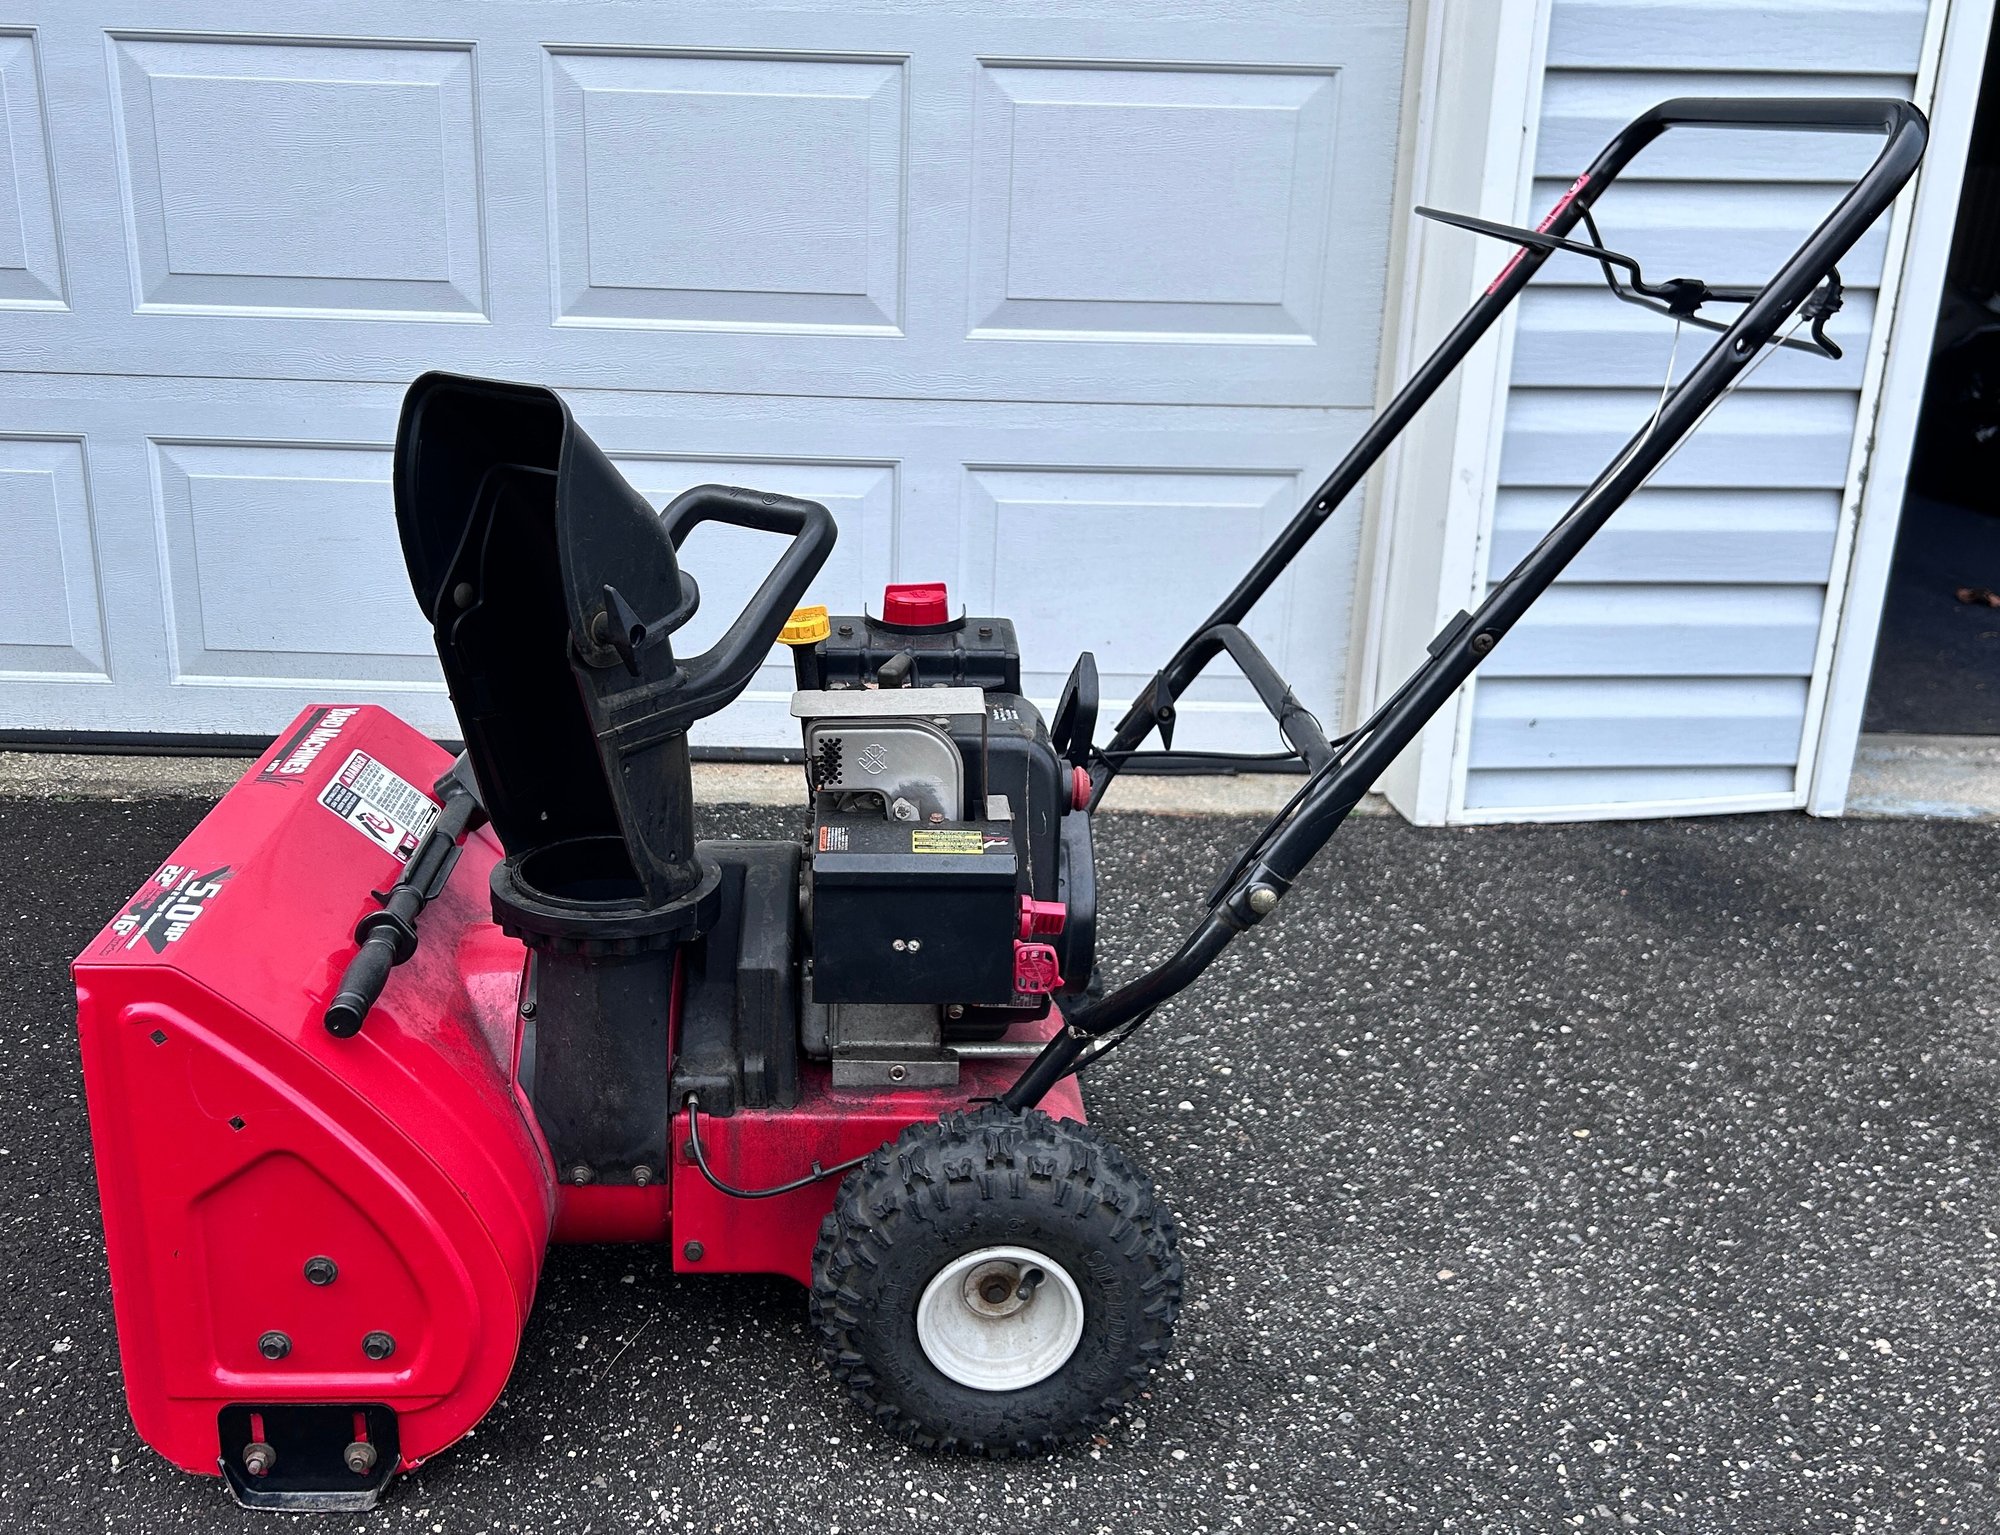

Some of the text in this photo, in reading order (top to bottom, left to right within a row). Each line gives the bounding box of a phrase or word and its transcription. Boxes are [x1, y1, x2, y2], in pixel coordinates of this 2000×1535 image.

[319, 707, 360, 728] YARD
[279, 728, 343, 774] MACHINES
[343, 754, 369, 780] DANGER
[163, 881, 223, 942] 5.0 HP
